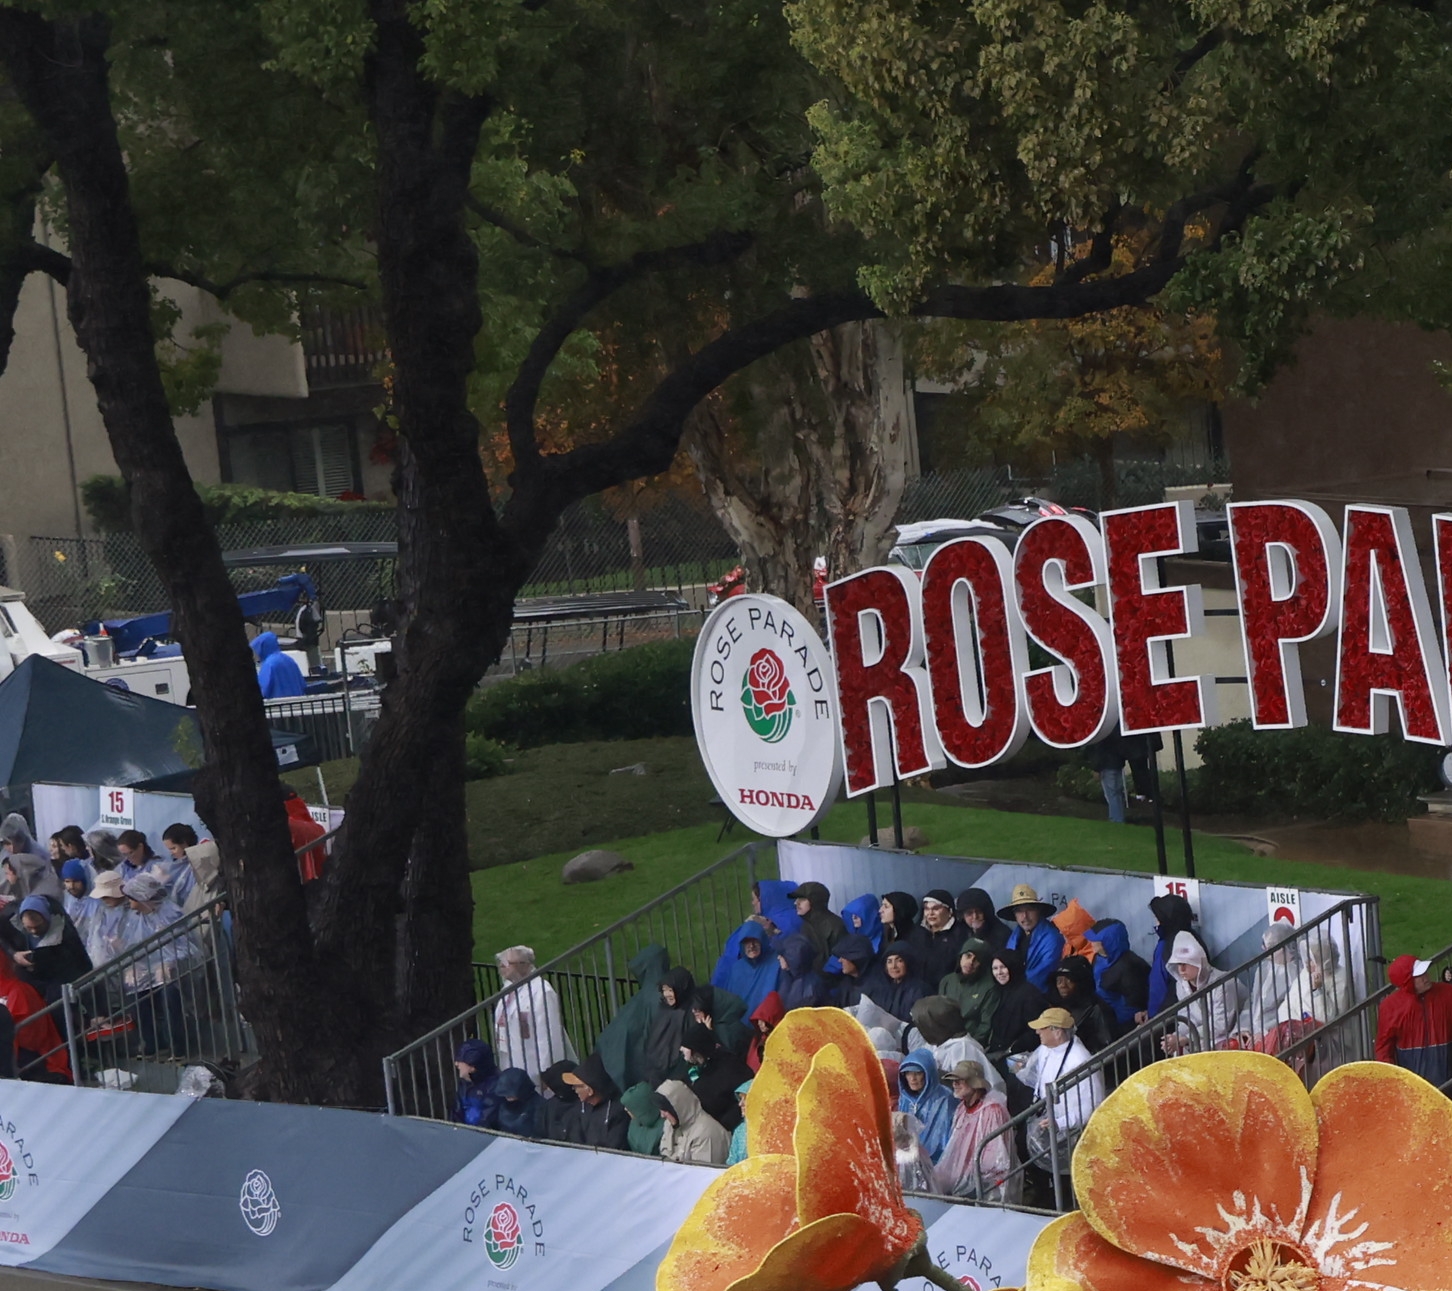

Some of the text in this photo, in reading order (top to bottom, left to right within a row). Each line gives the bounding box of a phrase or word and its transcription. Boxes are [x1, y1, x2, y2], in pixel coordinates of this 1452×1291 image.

[825, 500, 1212, 799] ROSE
[710, 608, 829, 720] ROSE PARADE
[754, 760, 798, 776] presented by
[108, 791, 124, 814] 15
[738, 788, 816, 811] HONDA
[311, 811, 327, 823] ISLE
[1165, 881, 1187, 900] 15
[1269, 891, 1296, 905] AISLE
[463, 1173, 545, 1257] ROSE PARADE
[0, 1231, 30, 1245] NDA
